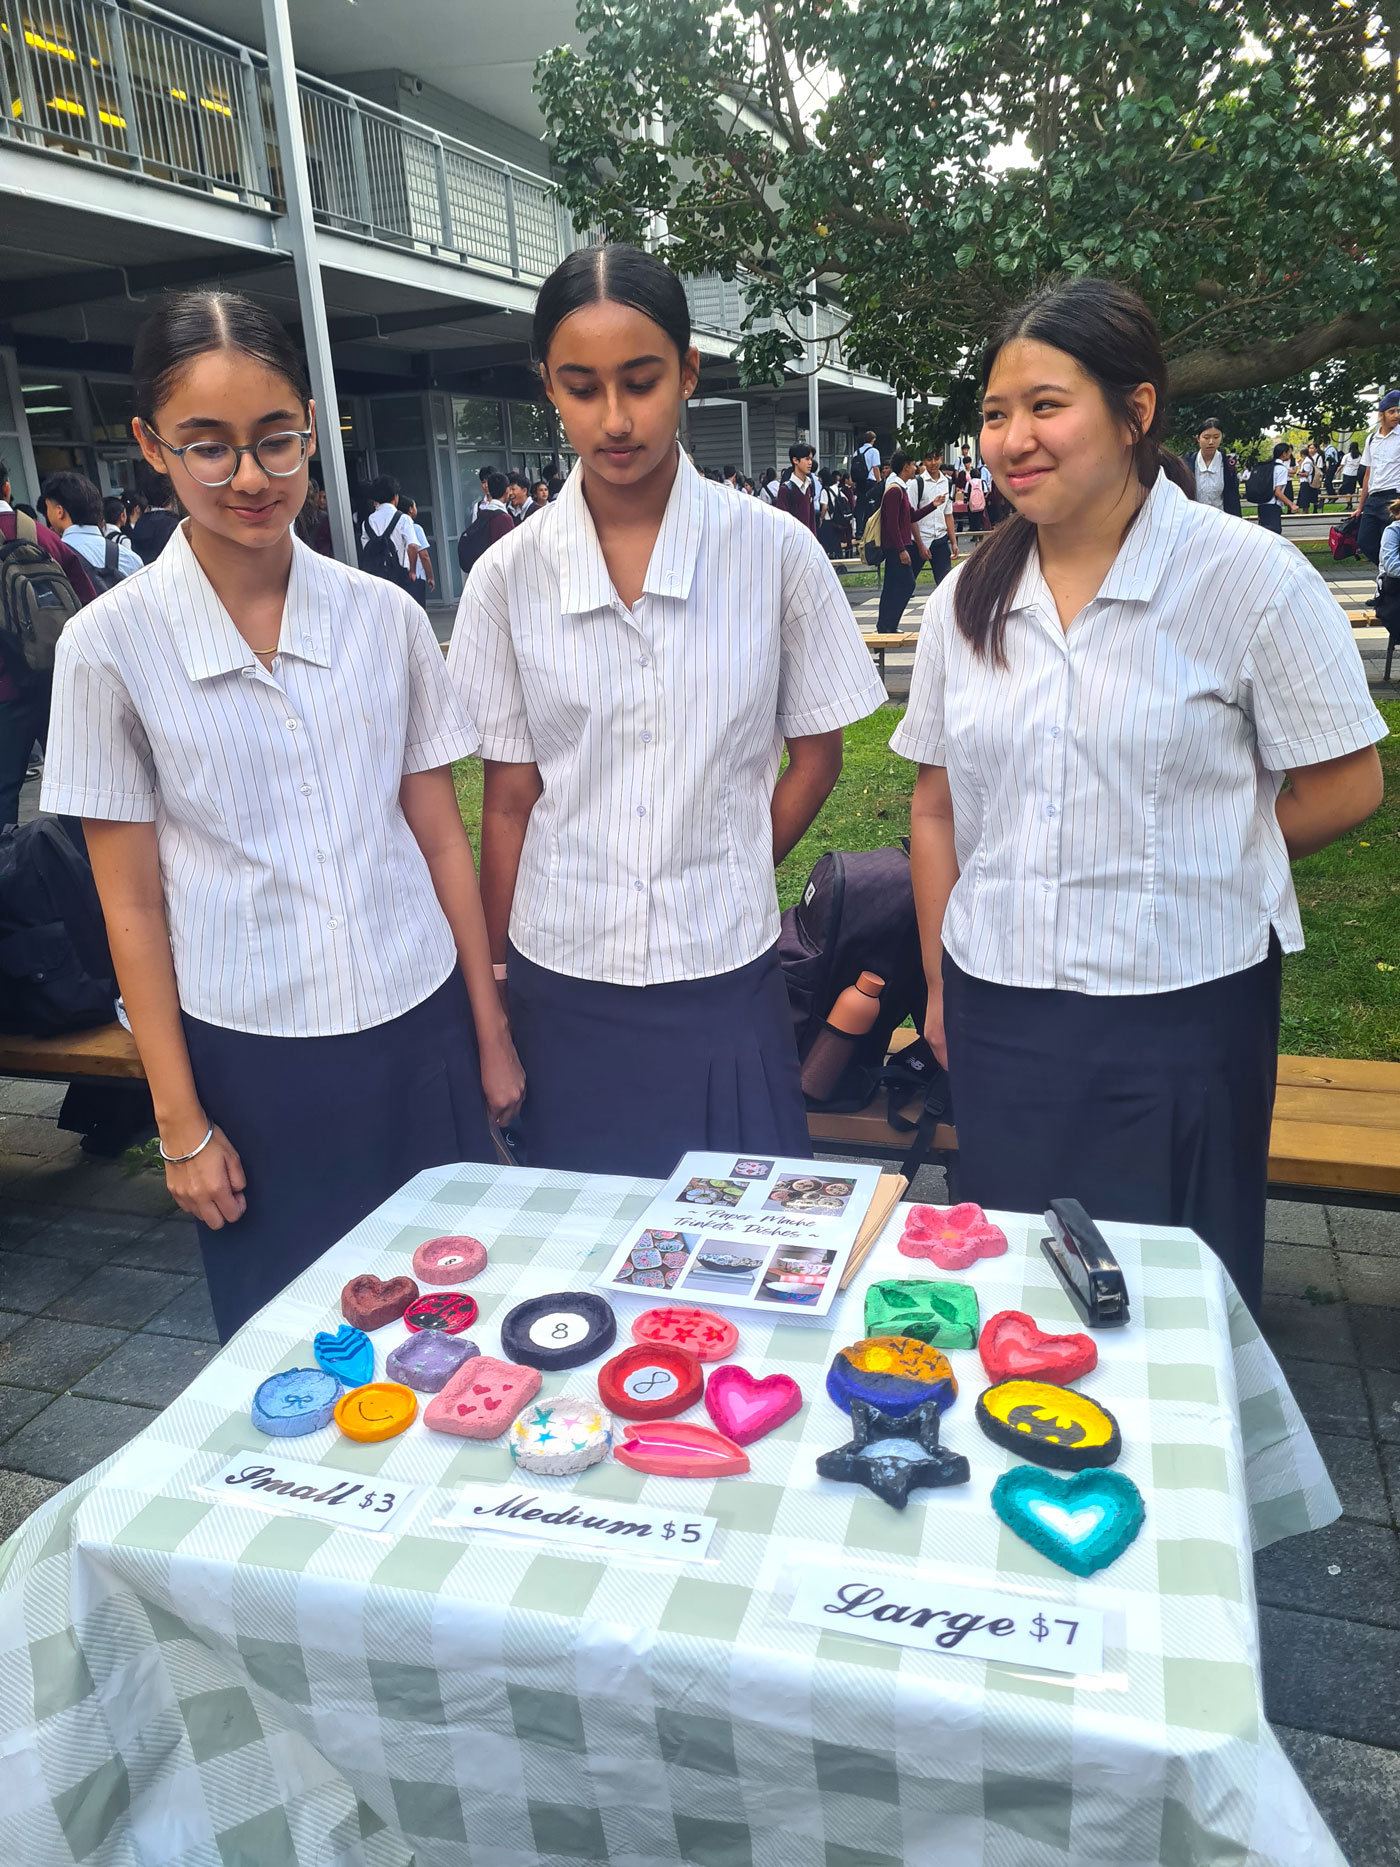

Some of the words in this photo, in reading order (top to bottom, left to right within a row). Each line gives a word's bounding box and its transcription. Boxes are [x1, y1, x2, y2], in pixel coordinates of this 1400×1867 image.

[674, 1217, 736, 1231] Trinkets
[742, 1224, 800, 1238] Dishes
[706, 1209, 755, 1221] Paper
[760, 1215, 816, 1227] Mache
[551, 1323, 568, 1339] 8
[225, 1466, 365, 1505] Small
[359, 1491, 396, 1513] $3
[473, 1494, 653, 1537] Medium
[661, 1520, 702, 1543] $5
[823, 1583, 1016, 1649] Large
[1029, 1612, 1079, 1645] $7
